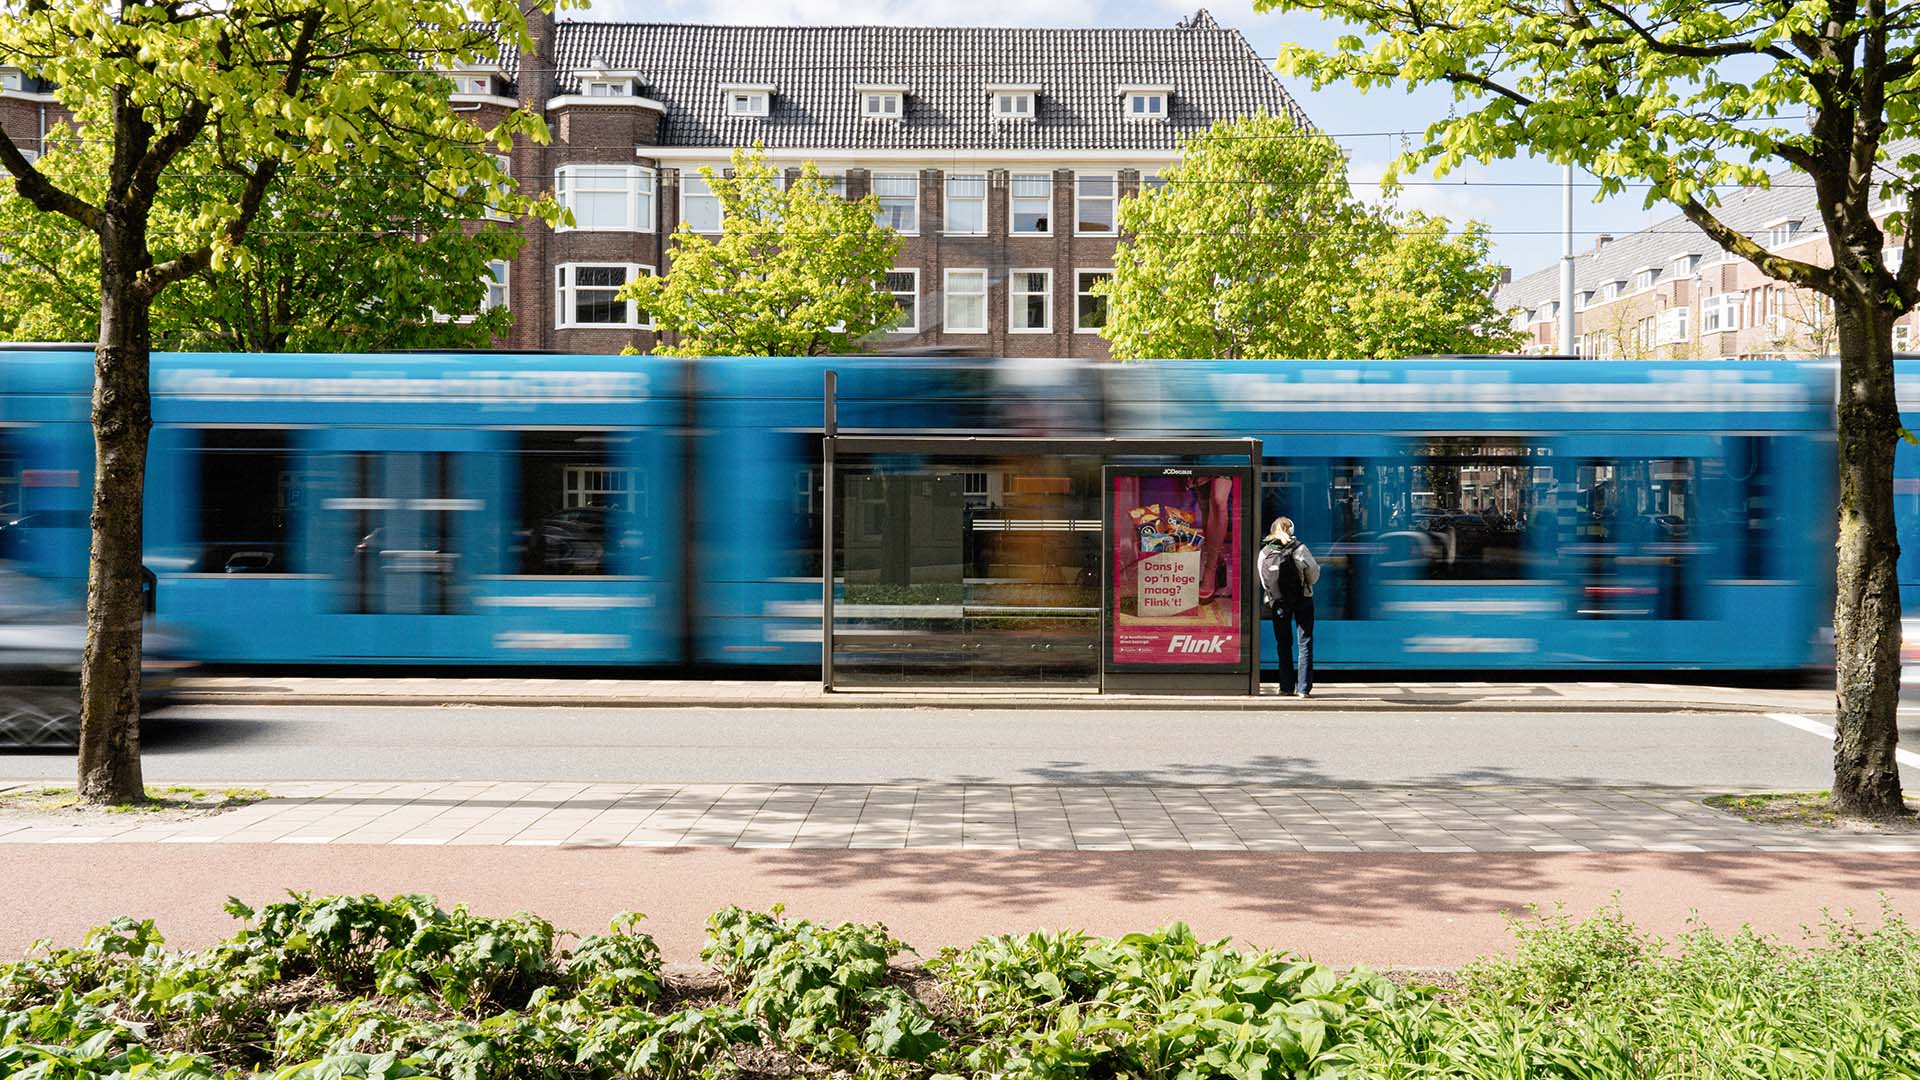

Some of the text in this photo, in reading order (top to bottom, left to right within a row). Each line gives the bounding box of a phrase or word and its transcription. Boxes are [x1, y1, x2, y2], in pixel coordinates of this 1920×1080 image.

[1144, 562, 1184, 573] Dans je
[1144, 575, 1159, 584] op
[1172, 574, 1195, 585] lege
[1144, 586, 1181, 597] maag?
[1144, 598, 1170, 607] Flink
[1168, 635, 1223, 653] Flink
